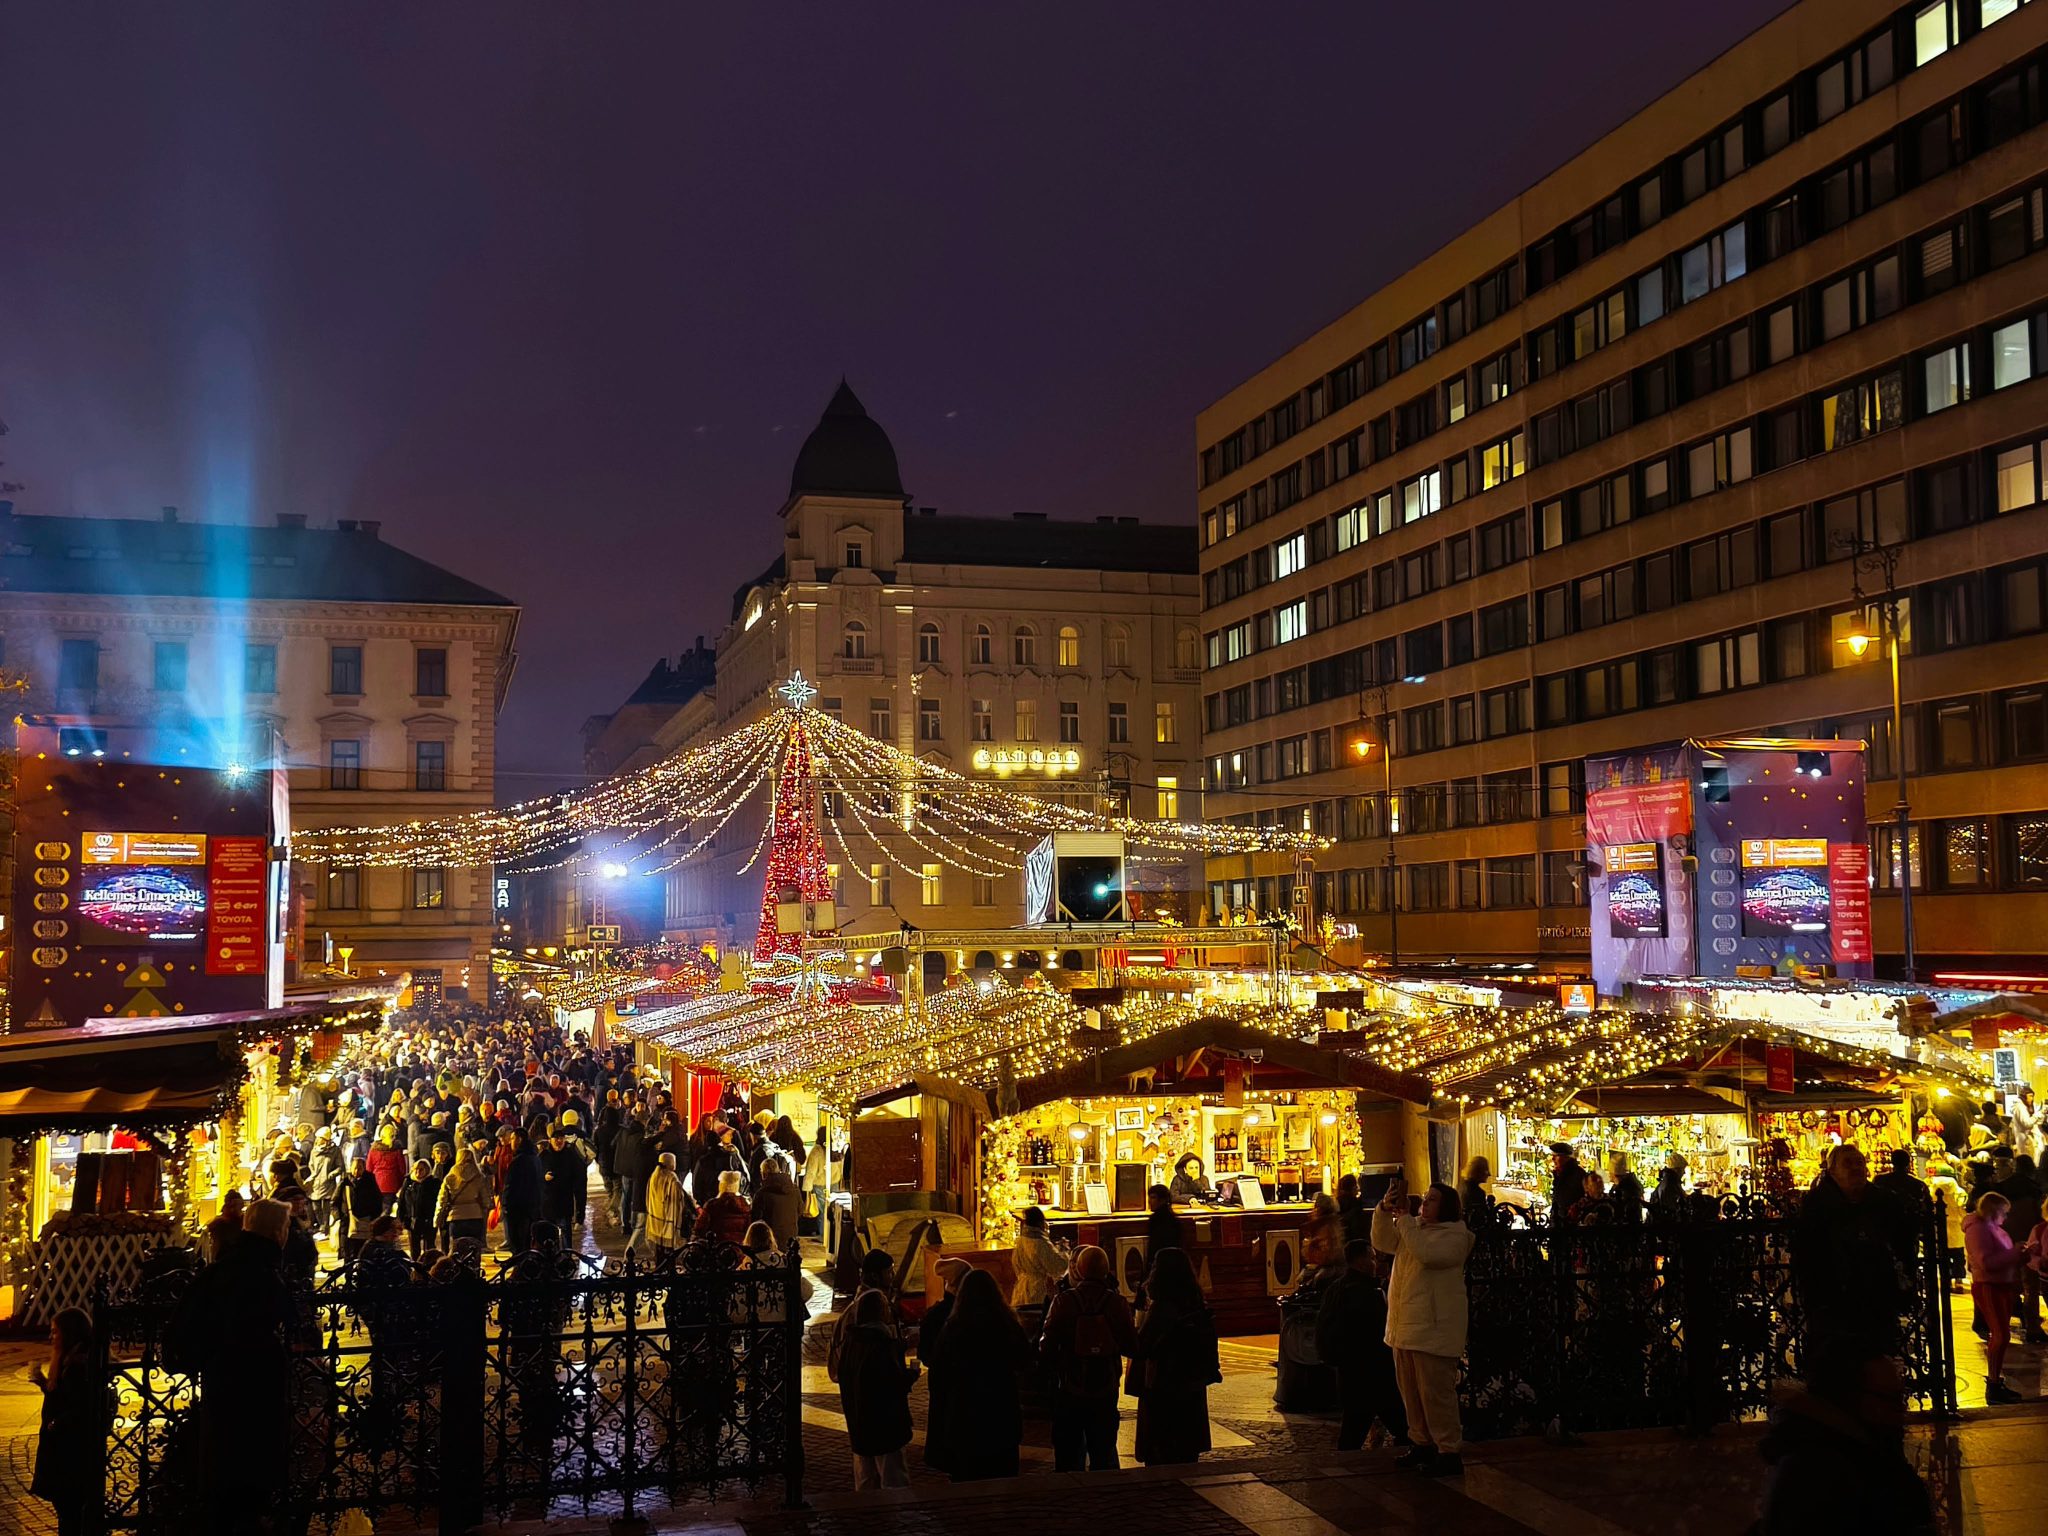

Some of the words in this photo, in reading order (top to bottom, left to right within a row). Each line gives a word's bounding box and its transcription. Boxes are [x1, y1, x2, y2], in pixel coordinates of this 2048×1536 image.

[497, 879, 509, 908] BAR
[216, 915, 252, 923] TOYOTA
[222, 935, 251, 943] nutella
